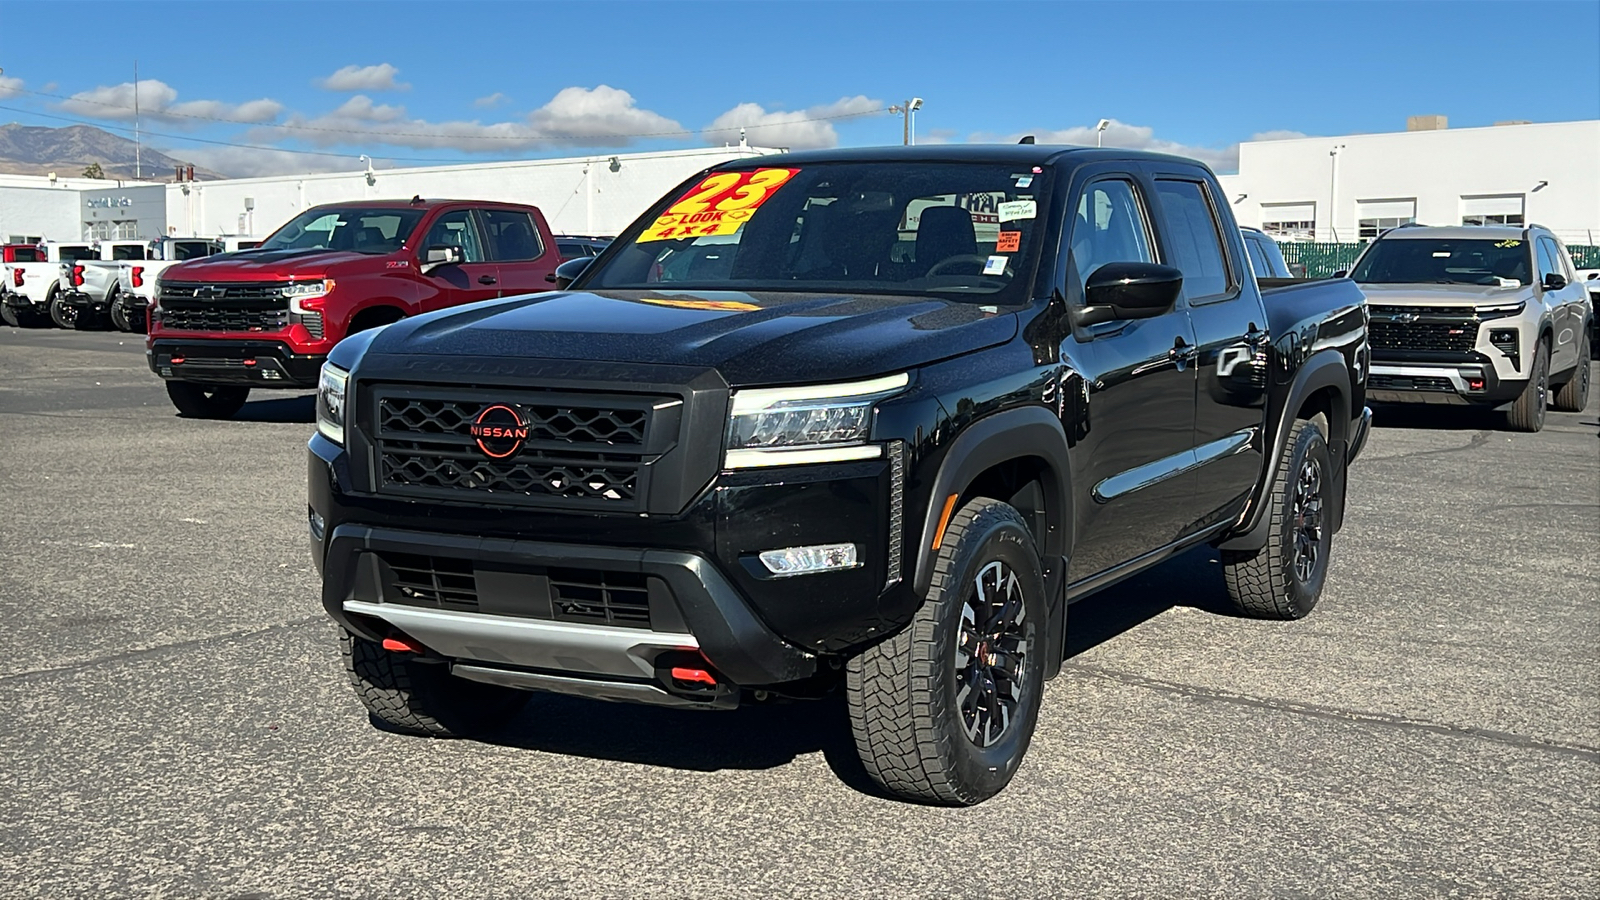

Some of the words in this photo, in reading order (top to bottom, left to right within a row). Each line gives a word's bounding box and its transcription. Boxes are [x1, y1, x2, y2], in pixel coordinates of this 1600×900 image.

[668, 169, 790, 214] 23
[679, 211, 727, 225] LOOK
[470, 426, 527, 438] NISSAN
